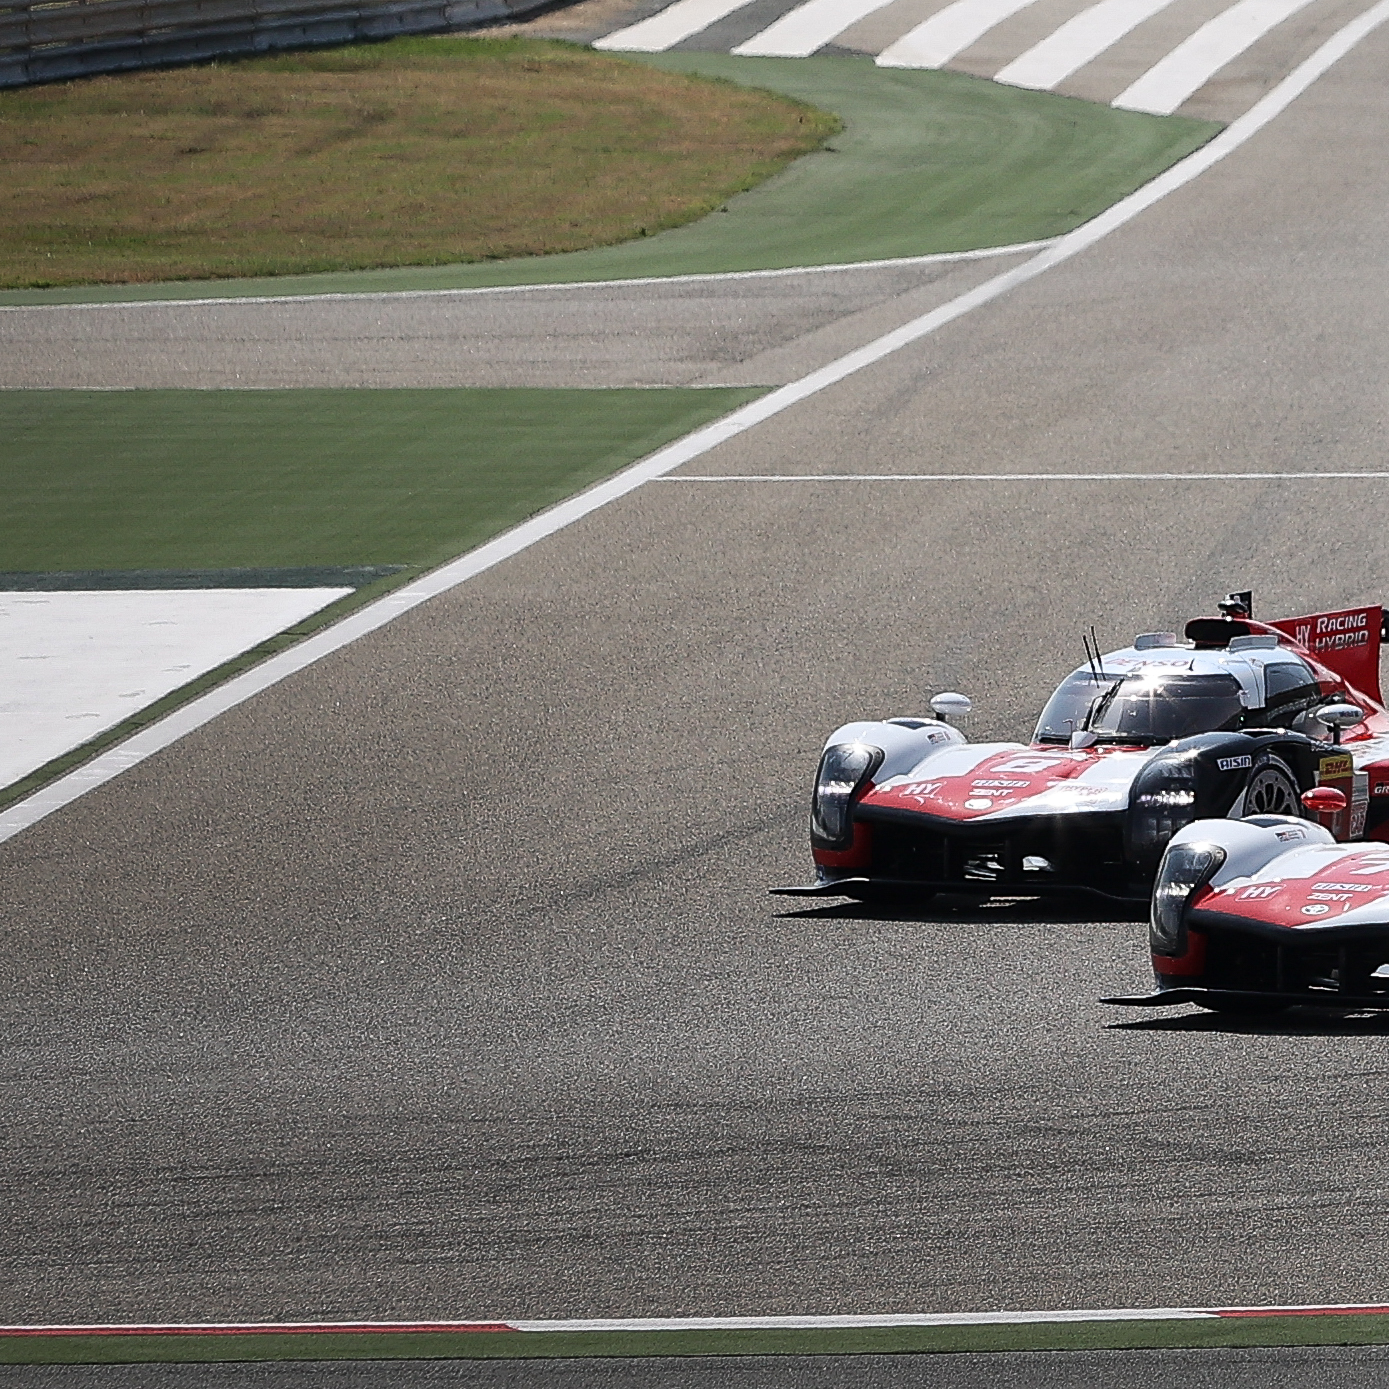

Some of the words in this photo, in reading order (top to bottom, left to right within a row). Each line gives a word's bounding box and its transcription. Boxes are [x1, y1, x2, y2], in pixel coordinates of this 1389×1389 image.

[1296, 624, 1312, 648] HY
[1316, 612, 1368, 633] RACING
[1315, 630, 1369, 652] HYBRID
[1220, 756, 1251, 770] AISIN
[1323, 761, 1350, 775] DHL
[905, 782, 942, 797] HY
[1241, 885, 1280, 899] HY
[1306, 892, 1353, 901] ZENT
